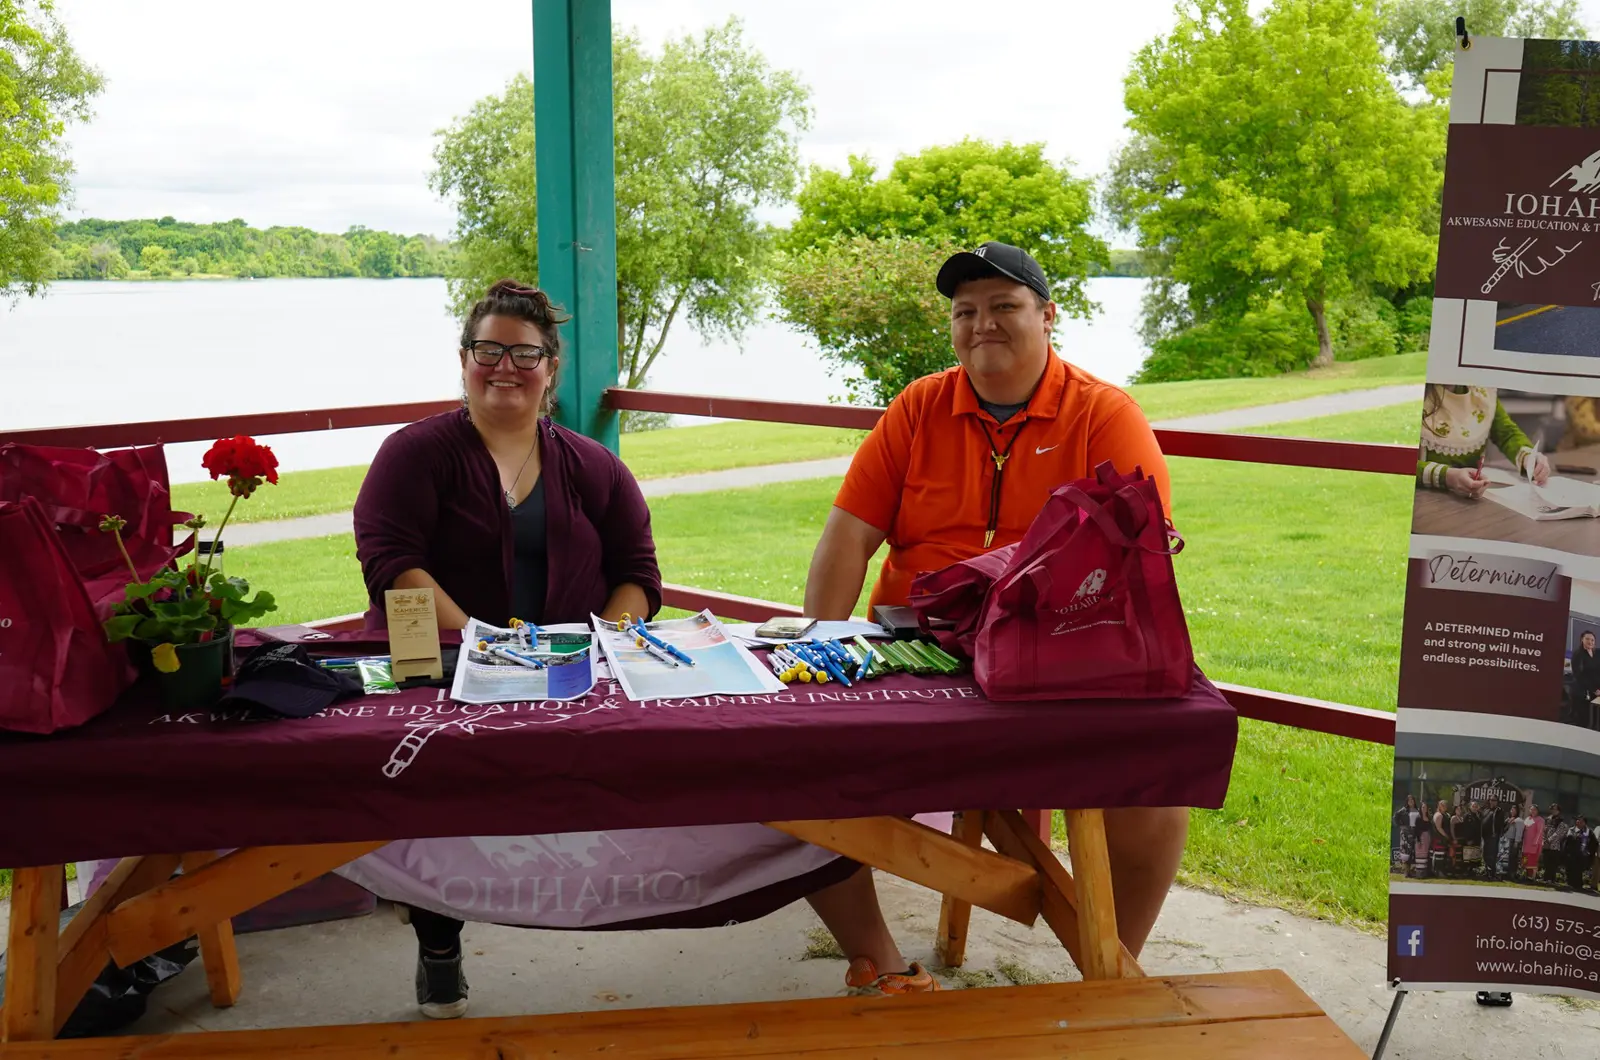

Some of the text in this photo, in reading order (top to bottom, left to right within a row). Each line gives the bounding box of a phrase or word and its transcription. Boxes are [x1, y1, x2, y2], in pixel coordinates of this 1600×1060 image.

[1446, 216, 1514, 228] AKWESASNE
[1516, 218, 1580, 232] EDUCATION
[1581, 223, 1591, 232] &
[1429, 554, 1558, 594] Determined
[1424, 621, 1544, 642] A DETERMINED mind
[1423, 637, 1542, 658] and strong will have
[1422, 653, 1541, 673] endless possibilites.
[387, 699, 586, 717] EDUCATION
[600, 697, 621, 710] &
[639, 693, 798, 709] TRAINING
[806, 686, 979, 704] INSTITUTE
[1511, 913, 1600, 939] (613) 575-2
